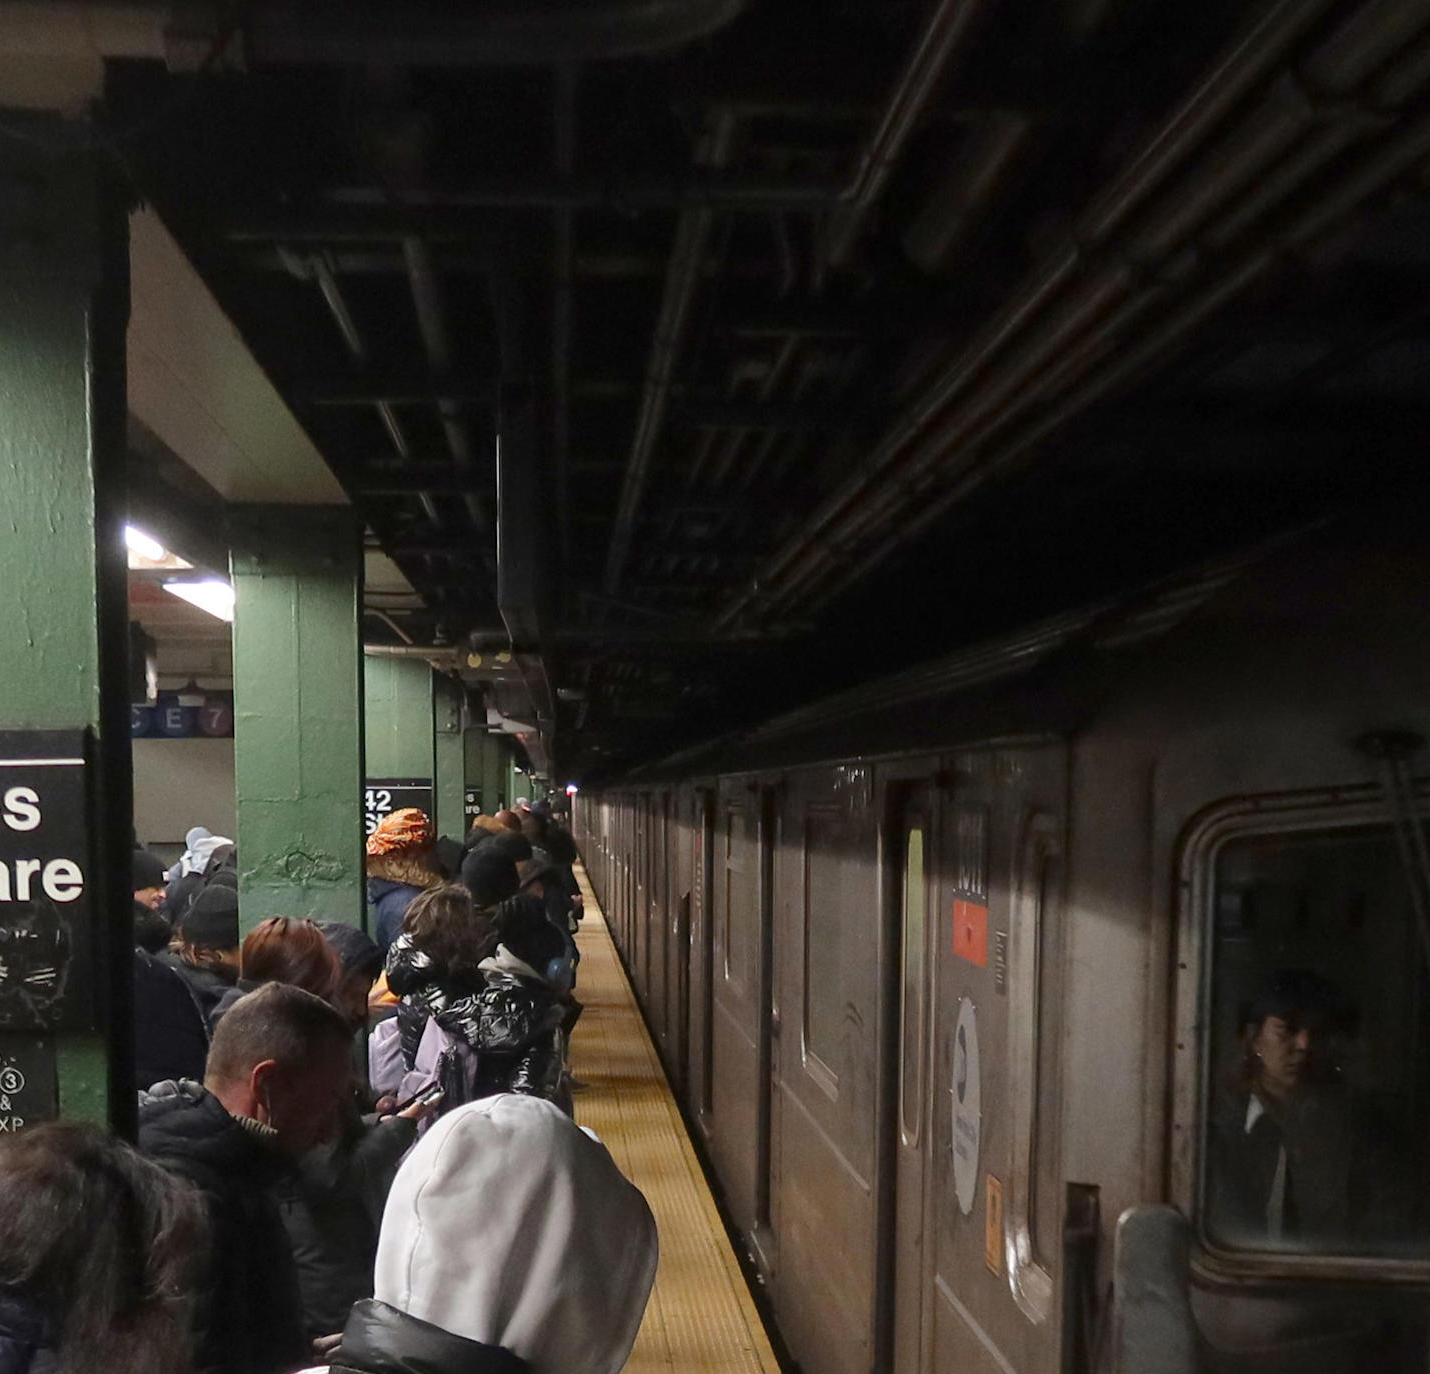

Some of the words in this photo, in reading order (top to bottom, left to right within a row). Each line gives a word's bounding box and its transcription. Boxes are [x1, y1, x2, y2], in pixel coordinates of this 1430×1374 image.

[166, 708, 181, 728] E
[209, 708, 223, 728] 7
[0, 1093, 12, 1111] &
